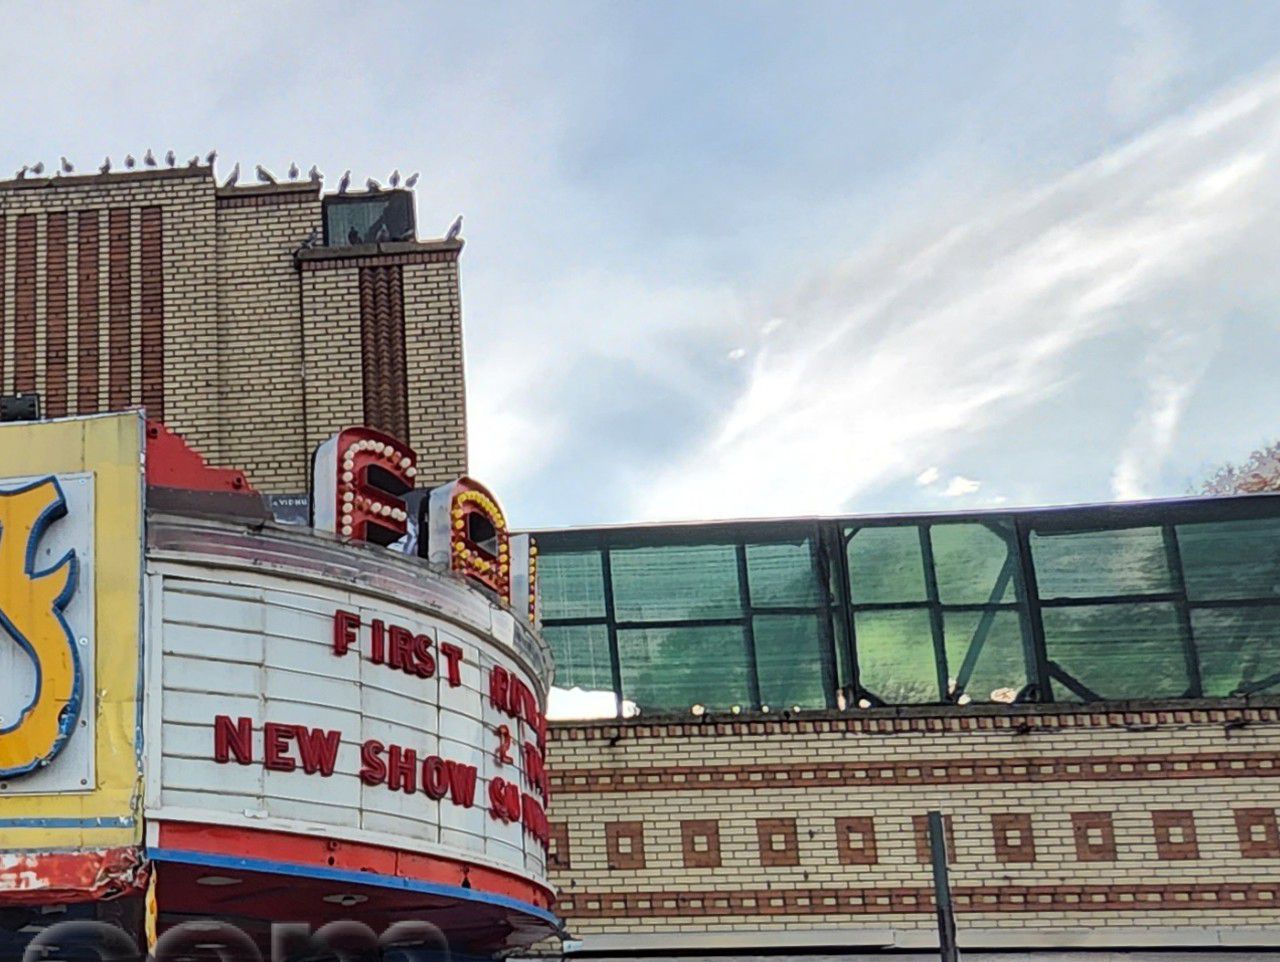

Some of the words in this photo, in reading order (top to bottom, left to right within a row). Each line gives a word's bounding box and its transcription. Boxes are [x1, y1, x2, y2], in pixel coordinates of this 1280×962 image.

[333, 609, 464, 688] FIRST
[214, 714, 341, 777] NEW
[360, 739, 477, 809] SHOW
